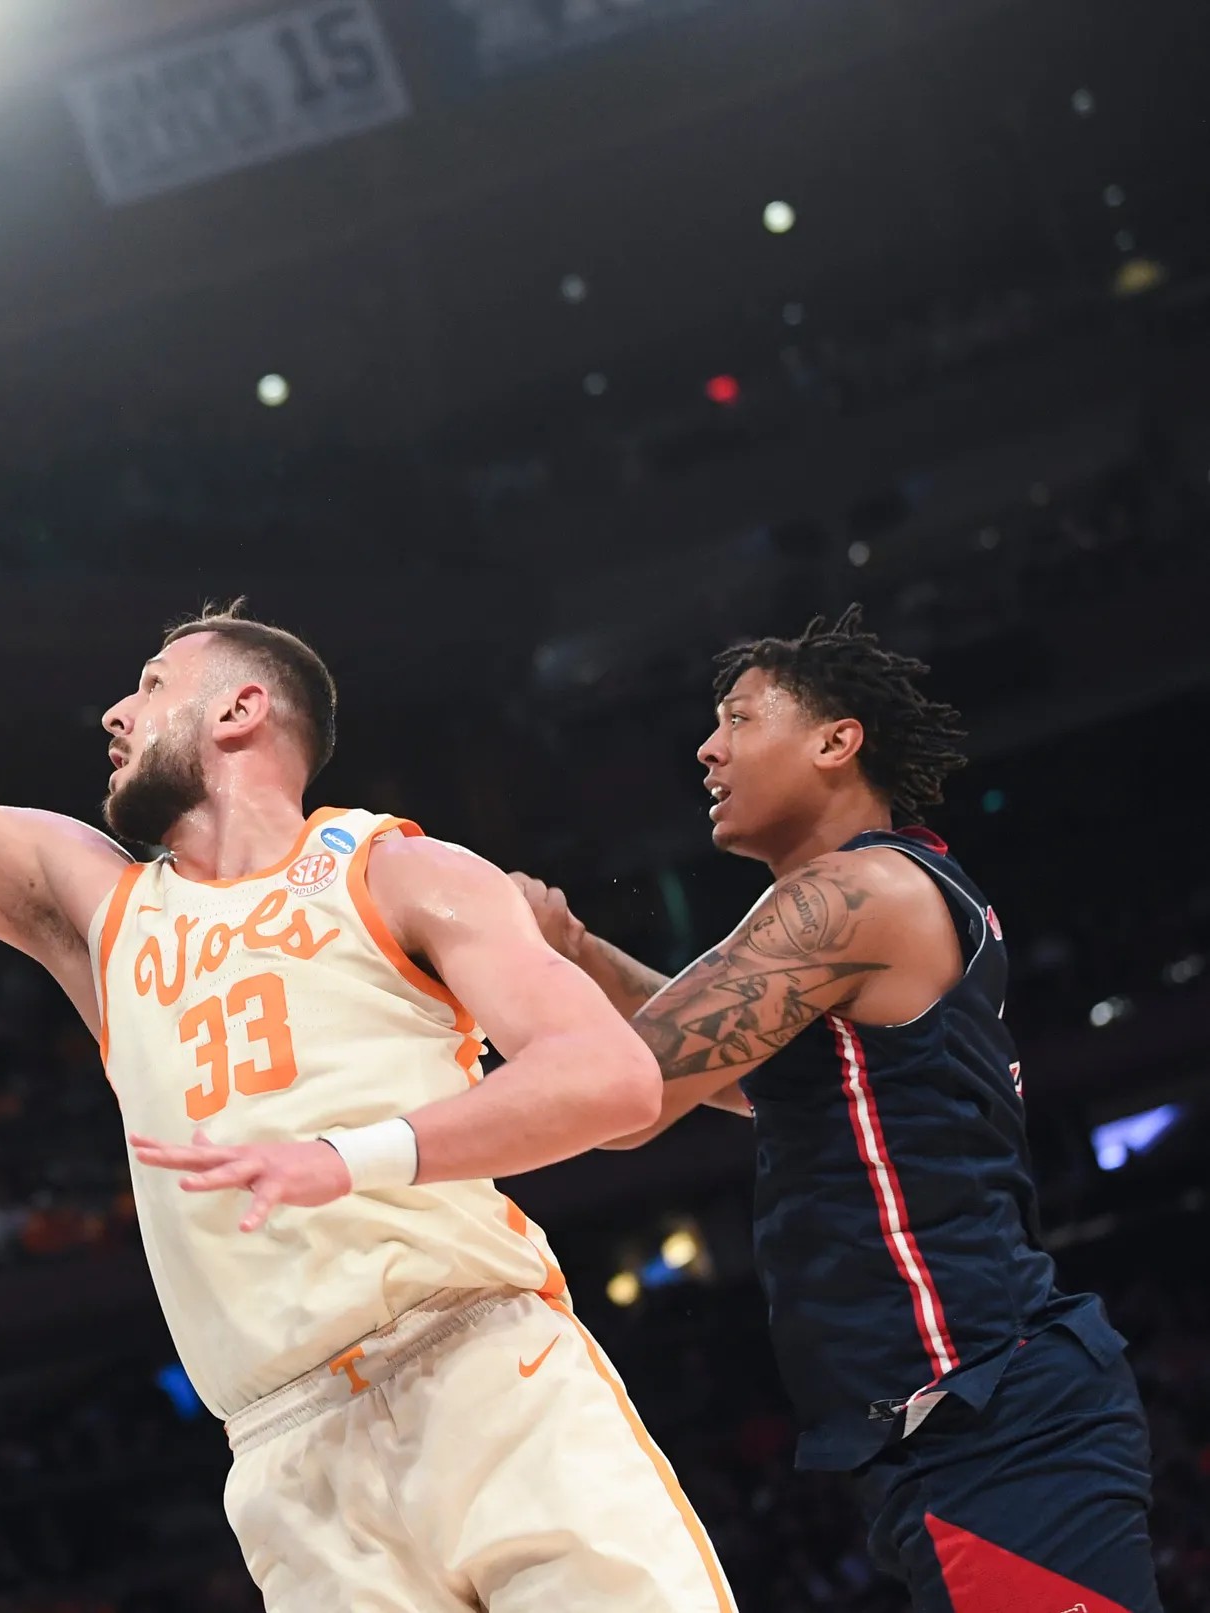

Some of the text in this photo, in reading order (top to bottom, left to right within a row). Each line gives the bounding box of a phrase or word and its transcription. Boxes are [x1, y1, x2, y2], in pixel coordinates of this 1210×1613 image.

[273, 5, 381, 107] 15
[323, 833, 352, 852] NCAA
[284, 877, 331, 896] GRADUATE
[291, 855, 332, 883] SEC
[134, 889, 341, 1007] Vols
[179, 972, 299, 1121] 33
[328, 1344, 371, 1395] T
